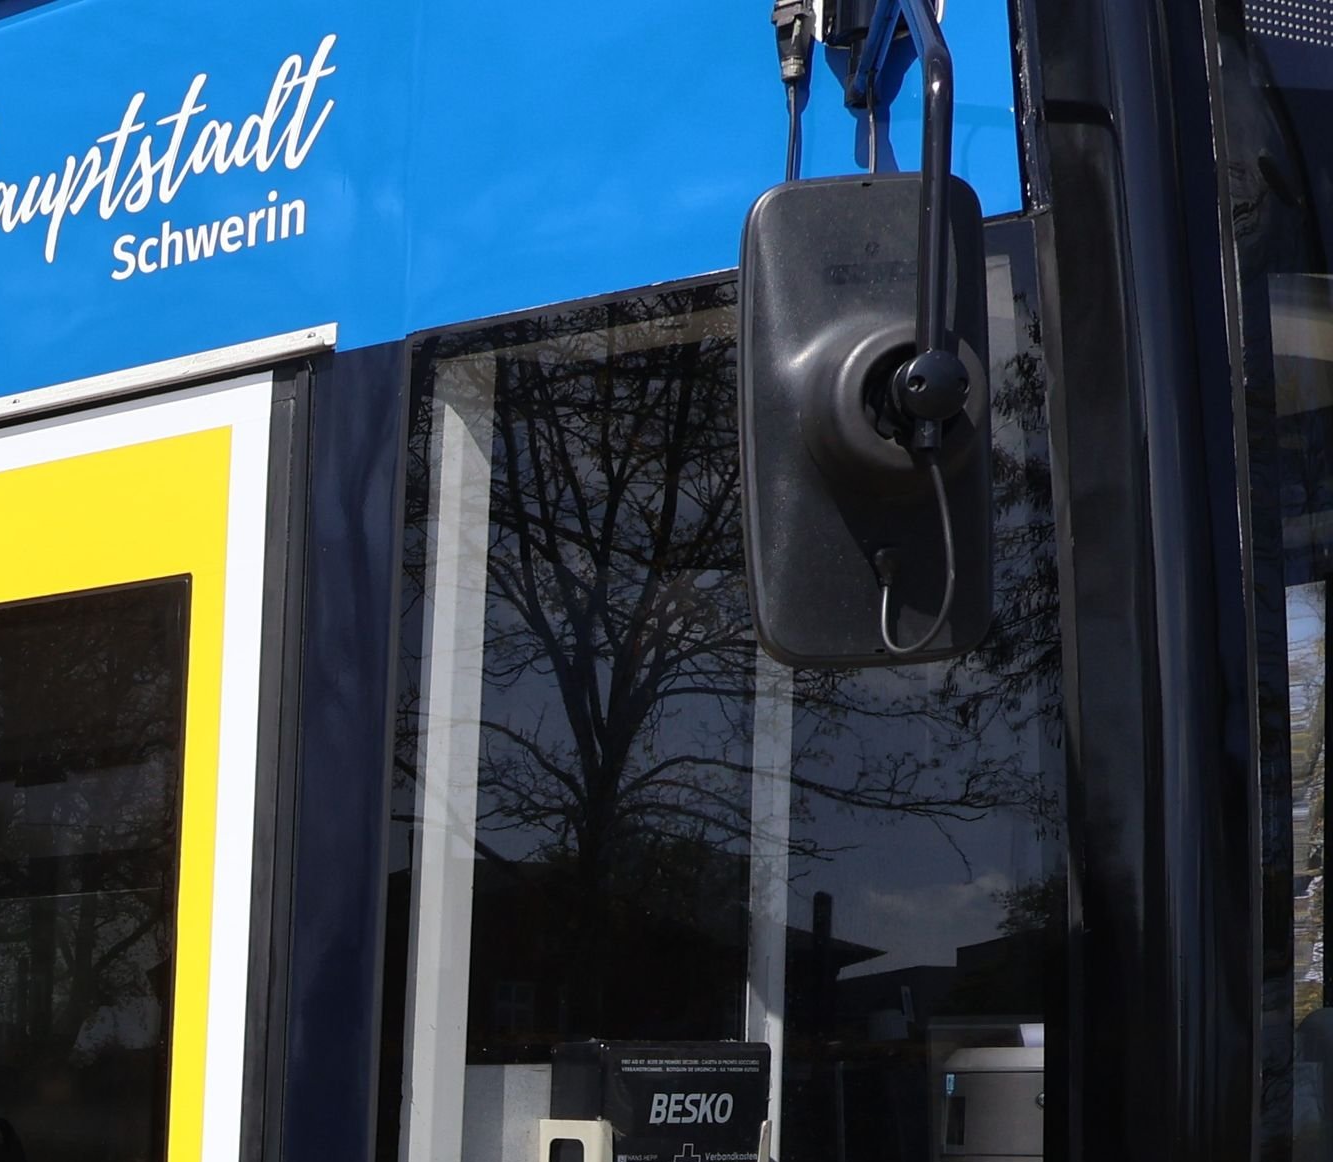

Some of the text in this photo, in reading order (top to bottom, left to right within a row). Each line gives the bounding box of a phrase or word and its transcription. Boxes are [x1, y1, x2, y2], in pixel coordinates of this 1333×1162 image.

[110, 189, 307, 281] Schwerin
[648, 1092, 734, 1125] BESKO
[704, 1152, 758, 1161] Verbandkasten
